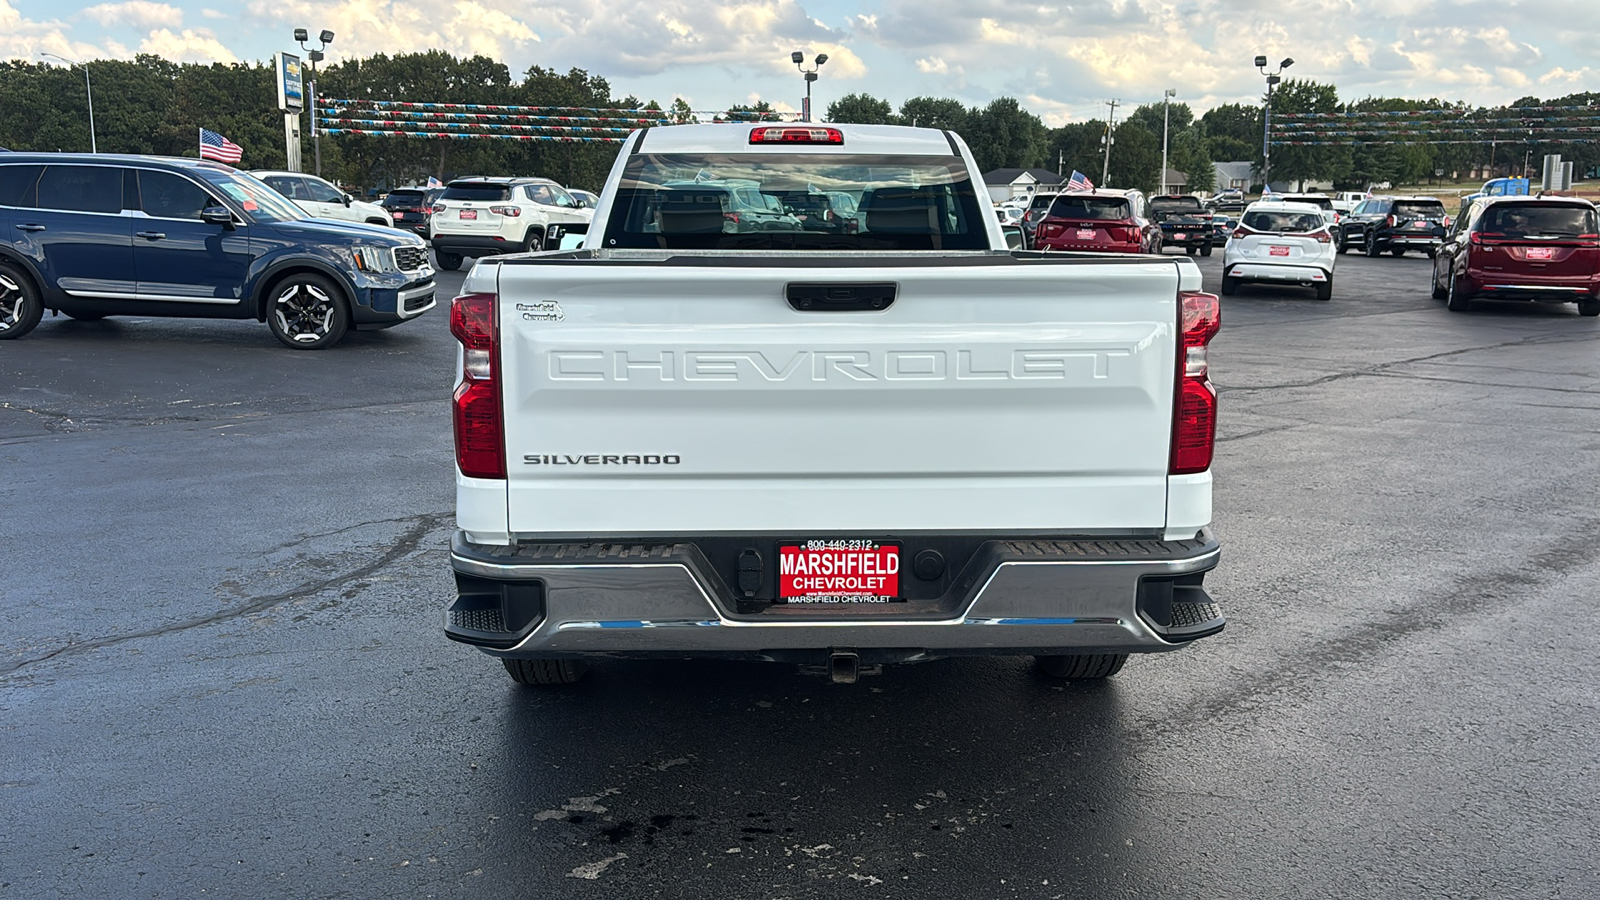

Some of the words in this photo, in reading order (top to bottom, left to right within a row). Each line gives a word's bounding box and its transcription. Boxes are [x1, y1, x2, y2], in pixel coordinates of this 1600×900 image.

[548, 347, 1131, 383] CHEVROLET
[523, 454, 681, 465] SILVERADO
[807, 540, 873, 548] 800-440-2312
[780, 553, 899, 575] MARSHFIELD
[792, 576, 886, 589] CHEVROLET
[788, 595, 839, 603] MARSHFIELD
[841, 595, 891, 603] CHEVROLET
